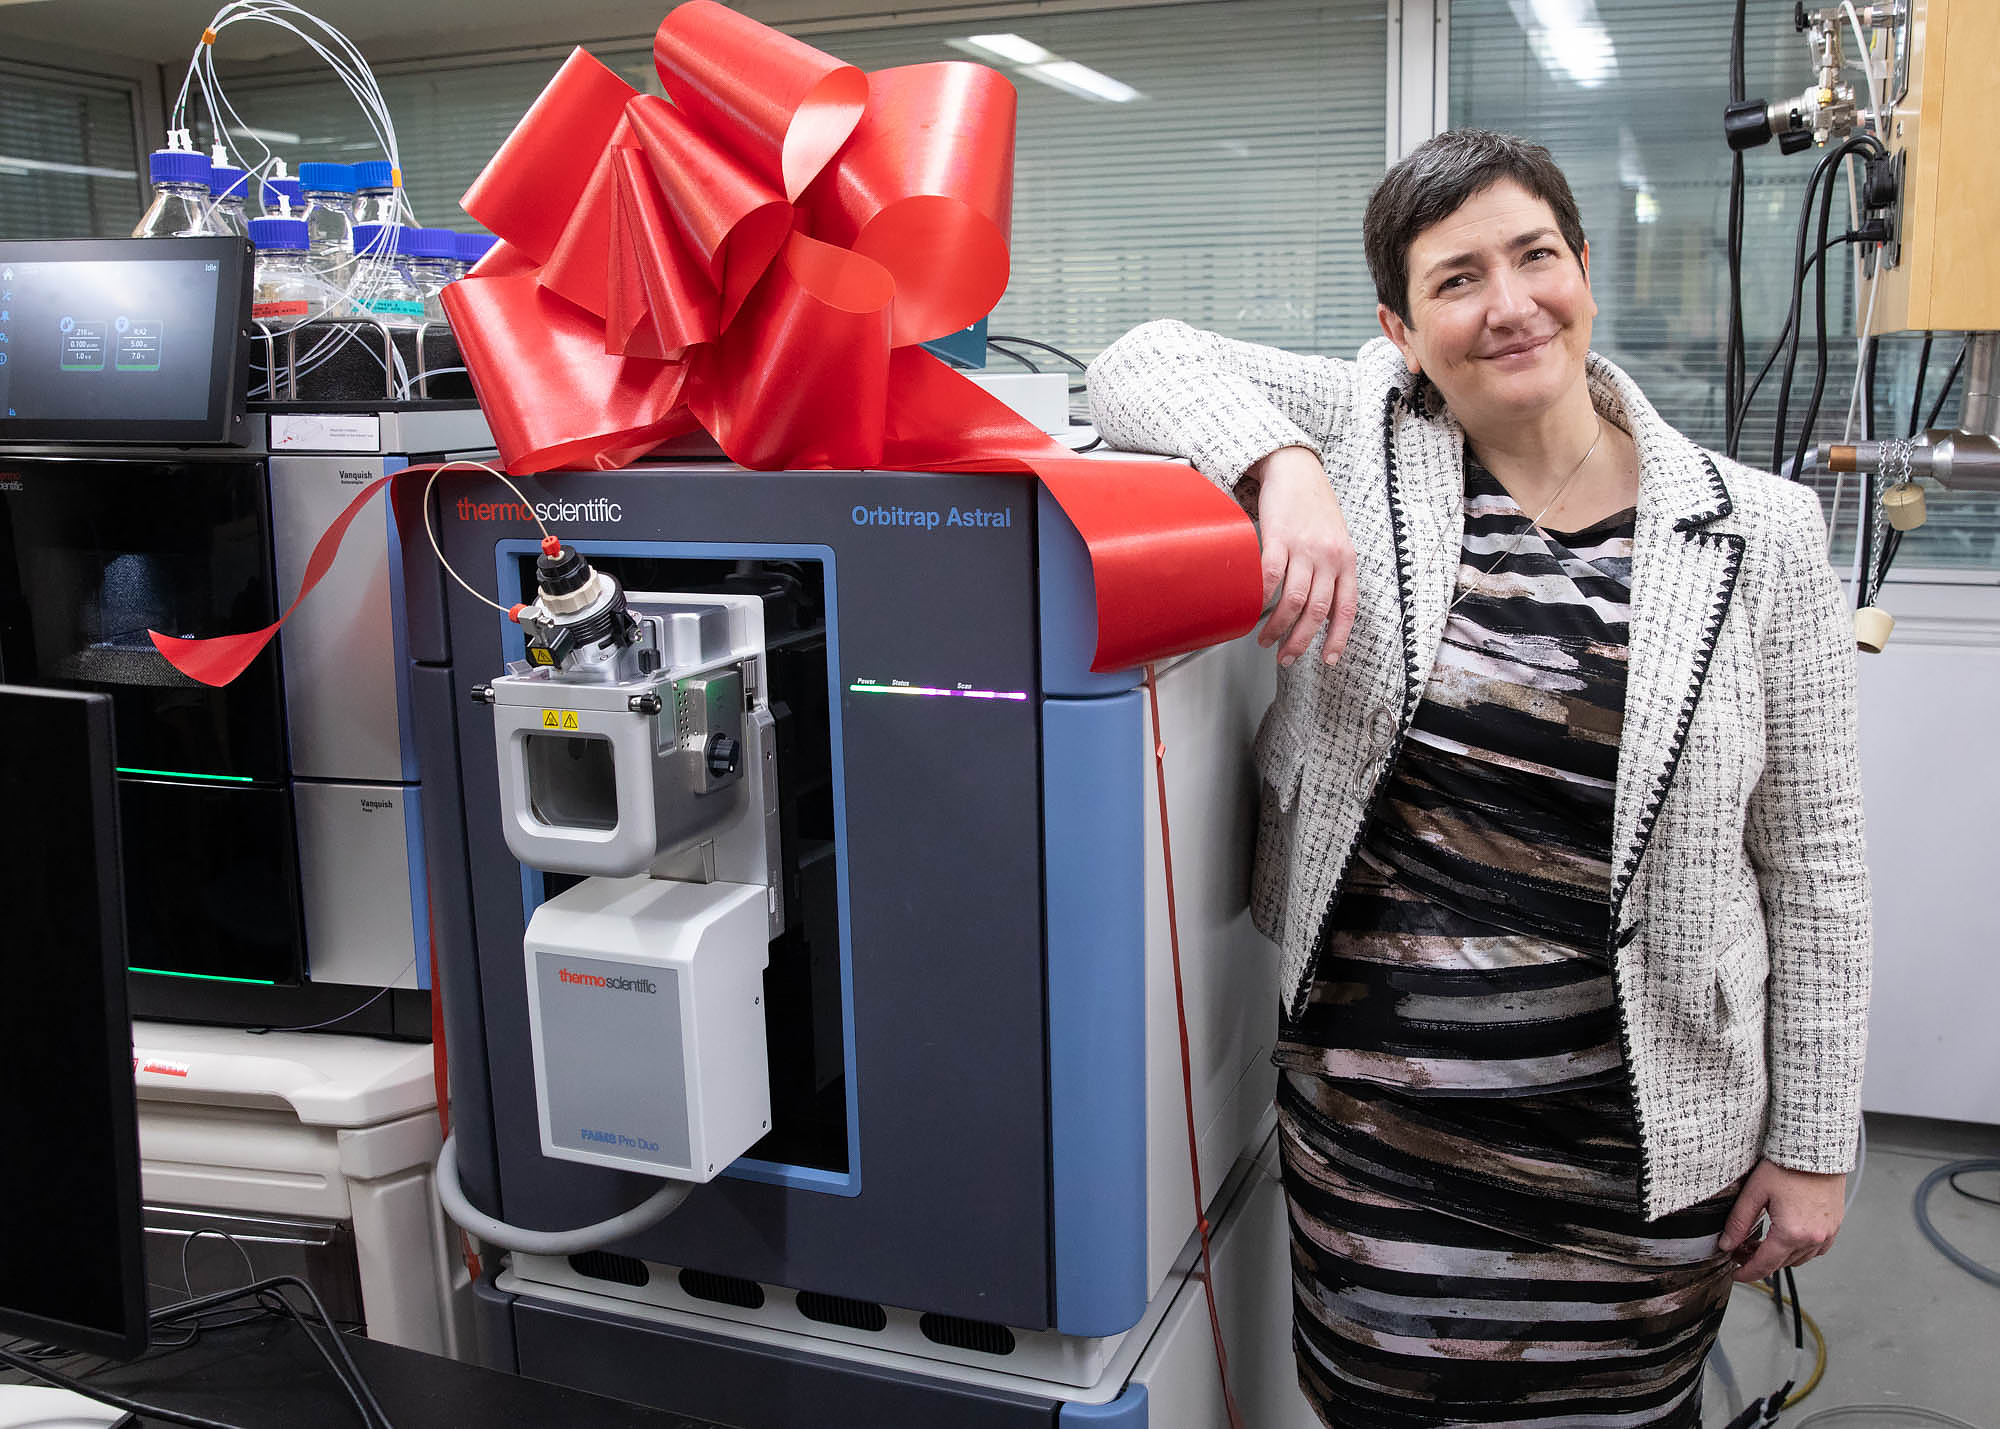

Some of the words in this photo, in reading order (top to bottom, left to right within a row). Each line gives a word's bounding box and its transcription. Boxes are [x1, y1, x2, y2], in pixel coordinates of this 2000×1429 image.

[339, 470, 373, 480] Vanquish
[851, 505, 940, 531] Orbitrap
[946, 506, 1011, 528] Astral
[857, 677, 876, 685] Power
[891, 679, 910, 687] Status
[957, 682, 972, 690] Scan
[360, 799, 393, 809] Vanquish
[617, 1134, 636, 1148] Pro
[638, 1136, 660, 1152] Duo
